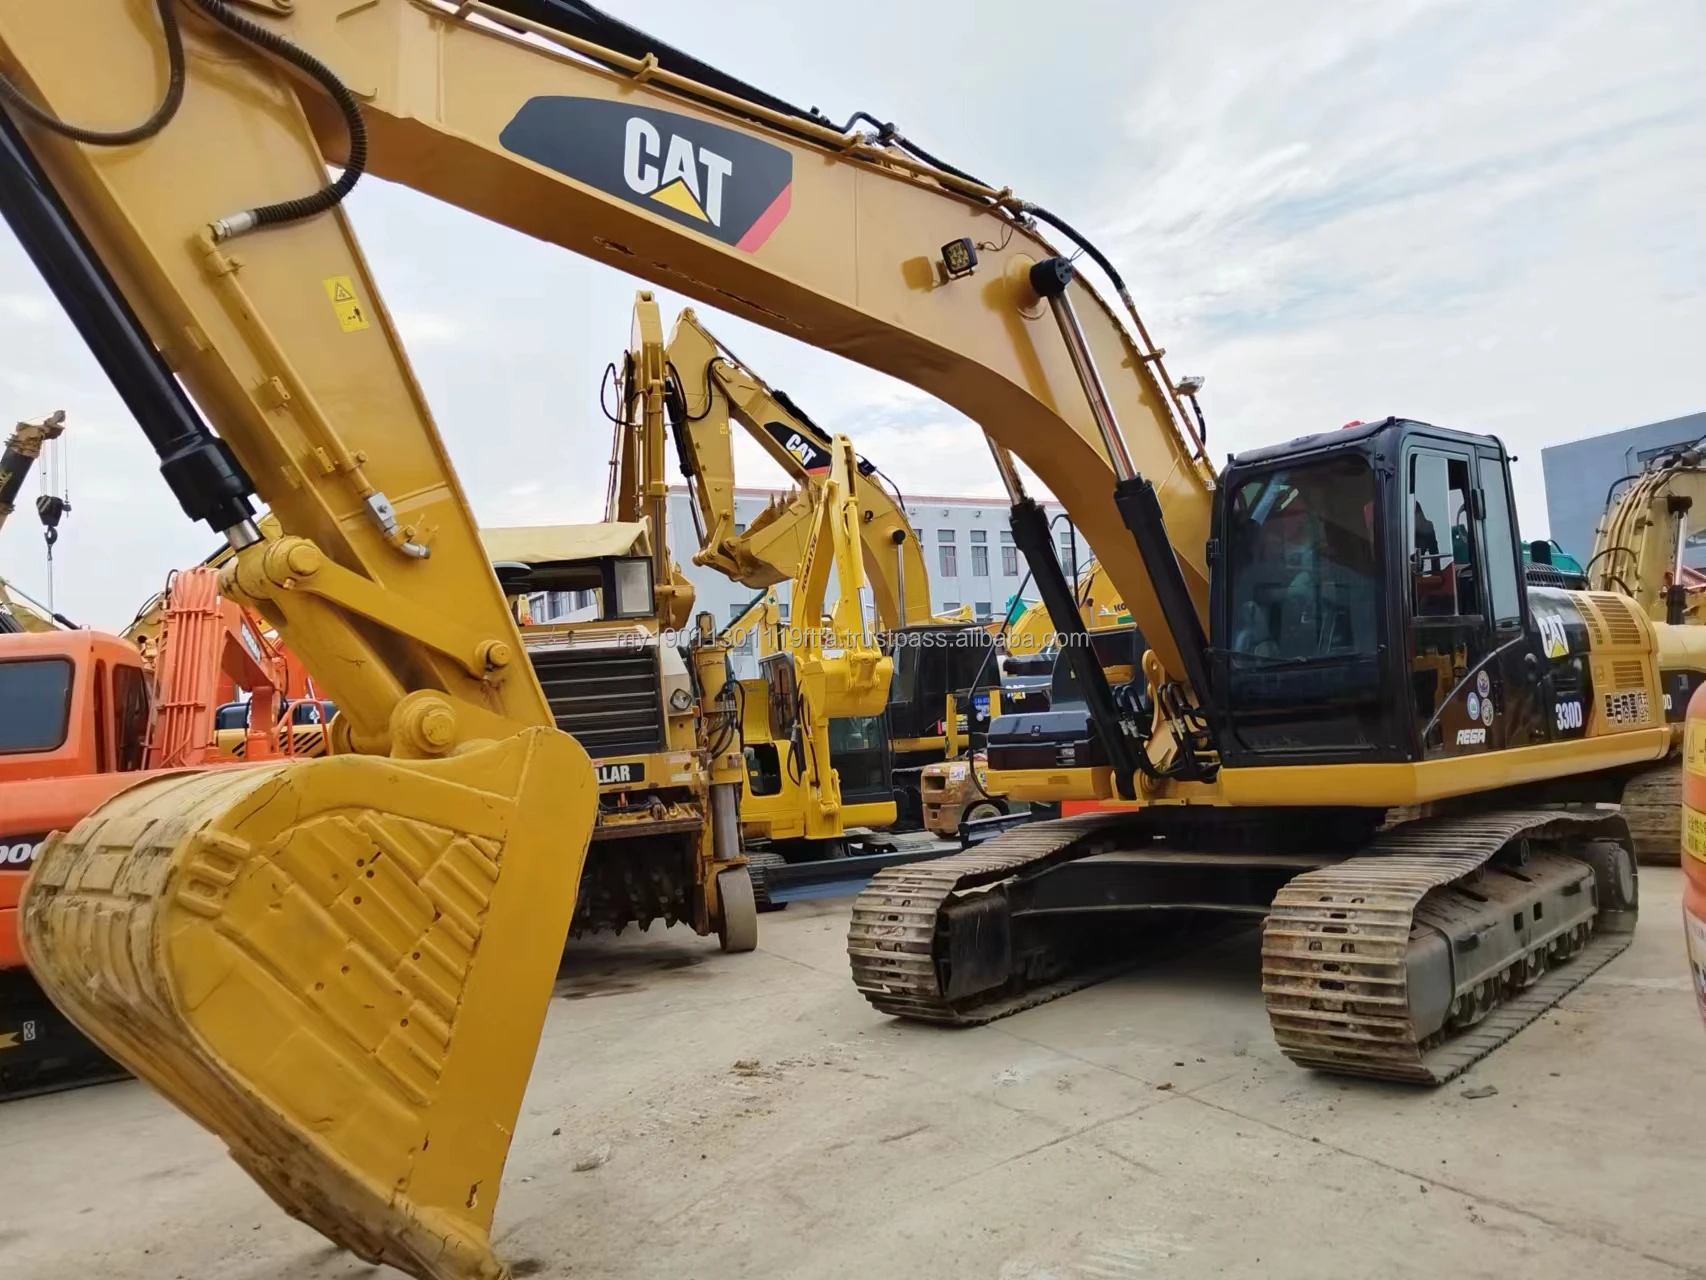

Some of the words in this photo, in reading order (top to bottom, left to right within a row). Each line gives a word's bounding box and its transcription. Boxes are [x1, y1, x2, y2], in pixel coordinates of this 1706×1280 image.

[623, 117, 732, 228] CAT
[785, 433, 817, 466] CAT
[1537, 614, 1570, 659] CAT
[1555, 701, 1583, 731] 330D
